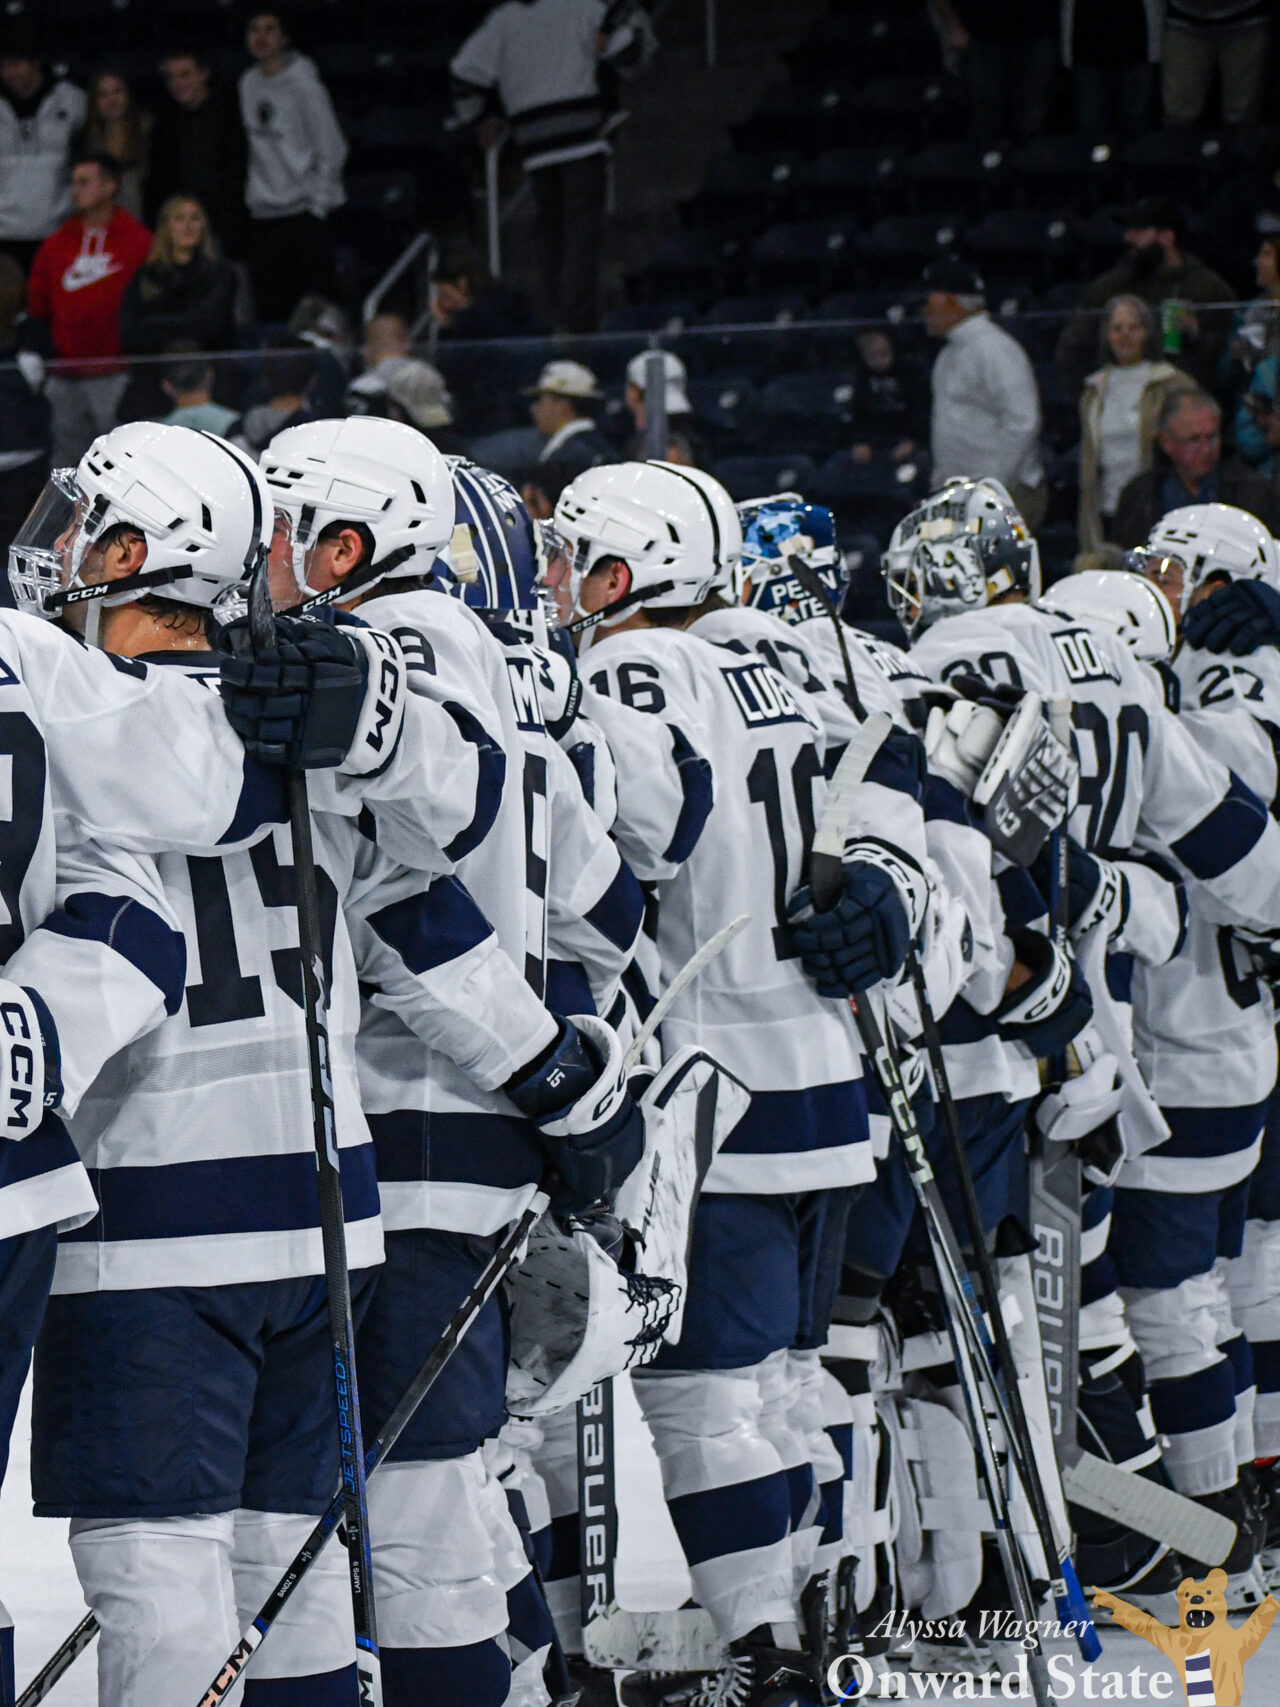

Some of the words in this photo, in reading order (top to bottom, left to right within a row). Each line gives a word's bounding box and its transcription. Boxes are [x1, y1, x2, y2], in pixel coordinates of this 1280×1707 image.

[66, 584, 108, 602] CCM
[302, 586, 342, 612] CCM
[571, 611, 605, 635] CCM
[365, 630, 399, 753] CCM
[589, 662, 666, 714] 16
[0, 1001, 35, 1128] CCM
[546, 1067, 566, 1088] 15
[43, 1091, 58, 1107] 5
[335, 1362, 356, 1494] JETSPEED
[277, 1578, 293, 1599] BANDZ
[289, 1572, 298, 1582] 15
